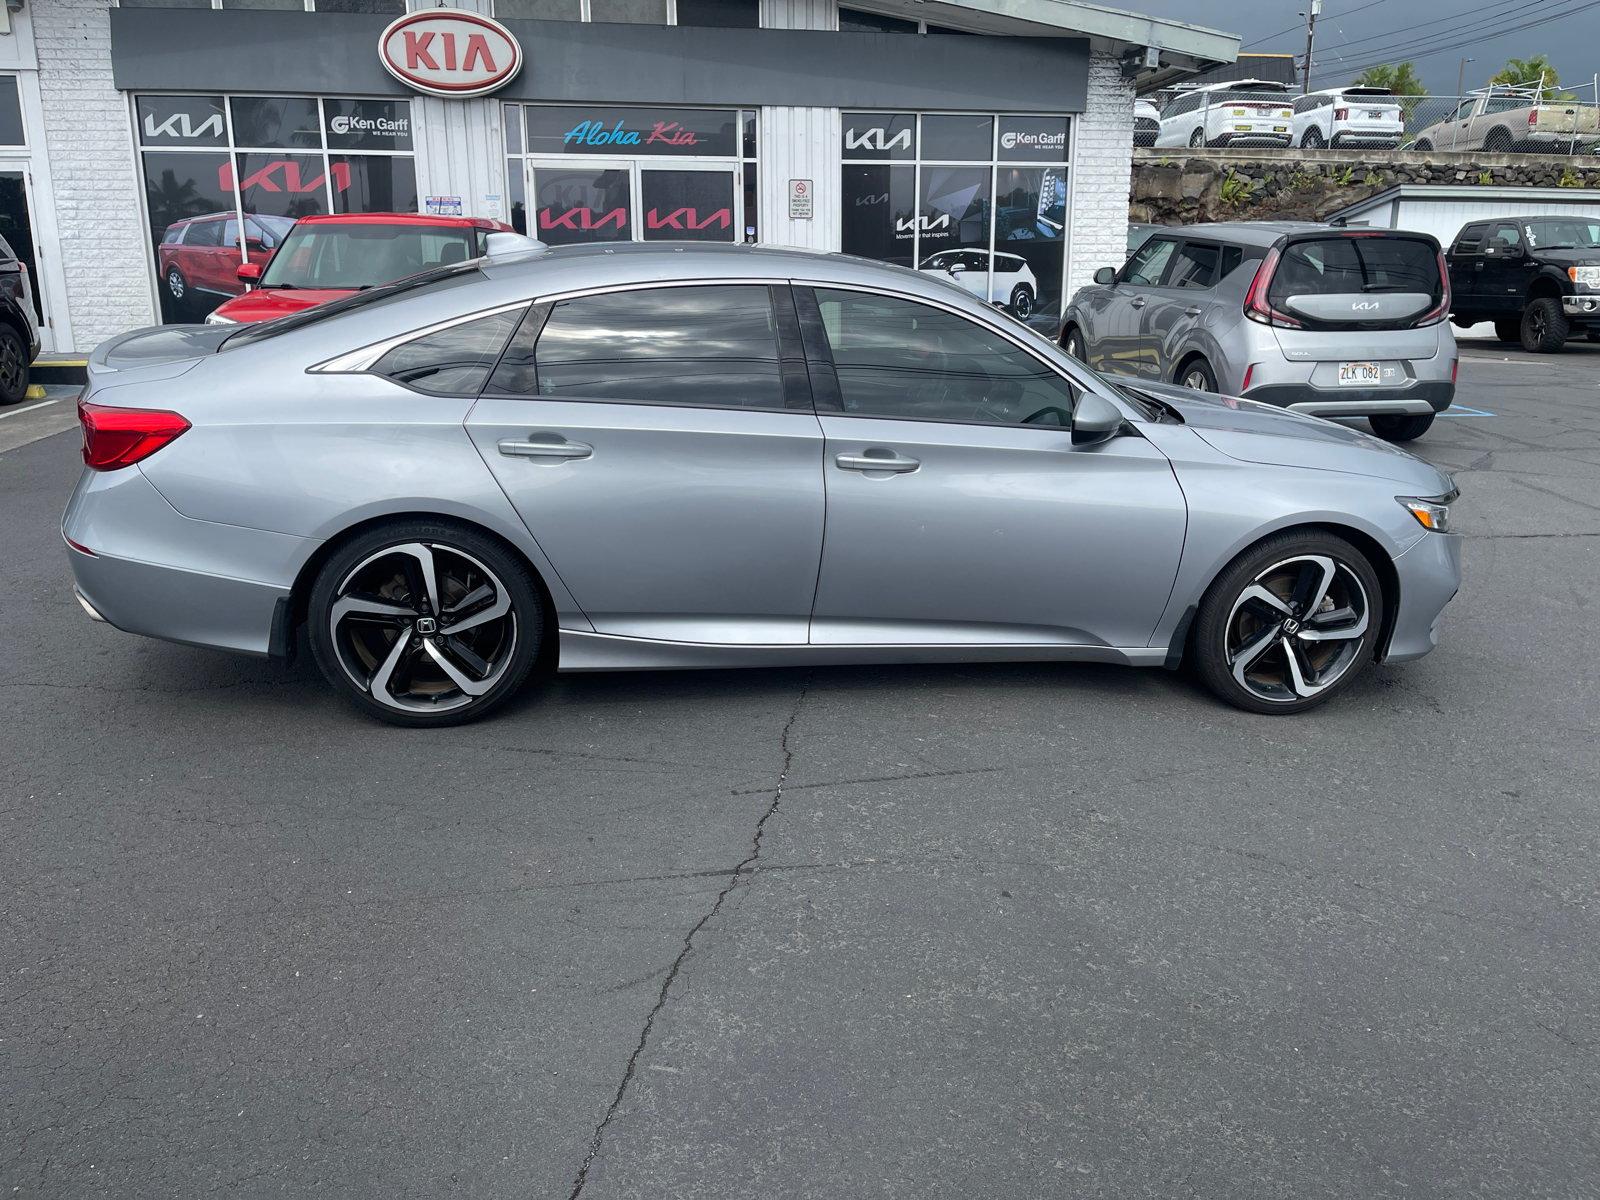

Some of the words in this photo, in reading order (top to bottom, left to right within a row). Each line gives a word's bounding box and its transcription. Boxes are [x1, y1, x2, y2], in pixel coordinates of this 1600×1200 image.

[403, 31, 497, 72] KIA
[144, 114, 223, 138] KIA
[350, 116, 375, 129] Ken
[376, 118, 408, 130] Garff
[564, 120, 641, 145] Aloha
[646, 121, 697, 145] Kia
[846, 128, 911, 150] KIA
[1017, 133, 1037, 144] Ken
[1039, 133, 1065, 144] Garff
[218, 161, 351, 192] KIA
[856, 193, 888, 206] KIA
[540, 207, 626, 229] KIA
[647, 207, 730, 229] KIA
[897, 214, 949, 231] KIA
[1352, 302, 1379, 310] KIA
[1341, 367, 1357, 379] ZLK
[1362, 367, 1378, 378] 082
